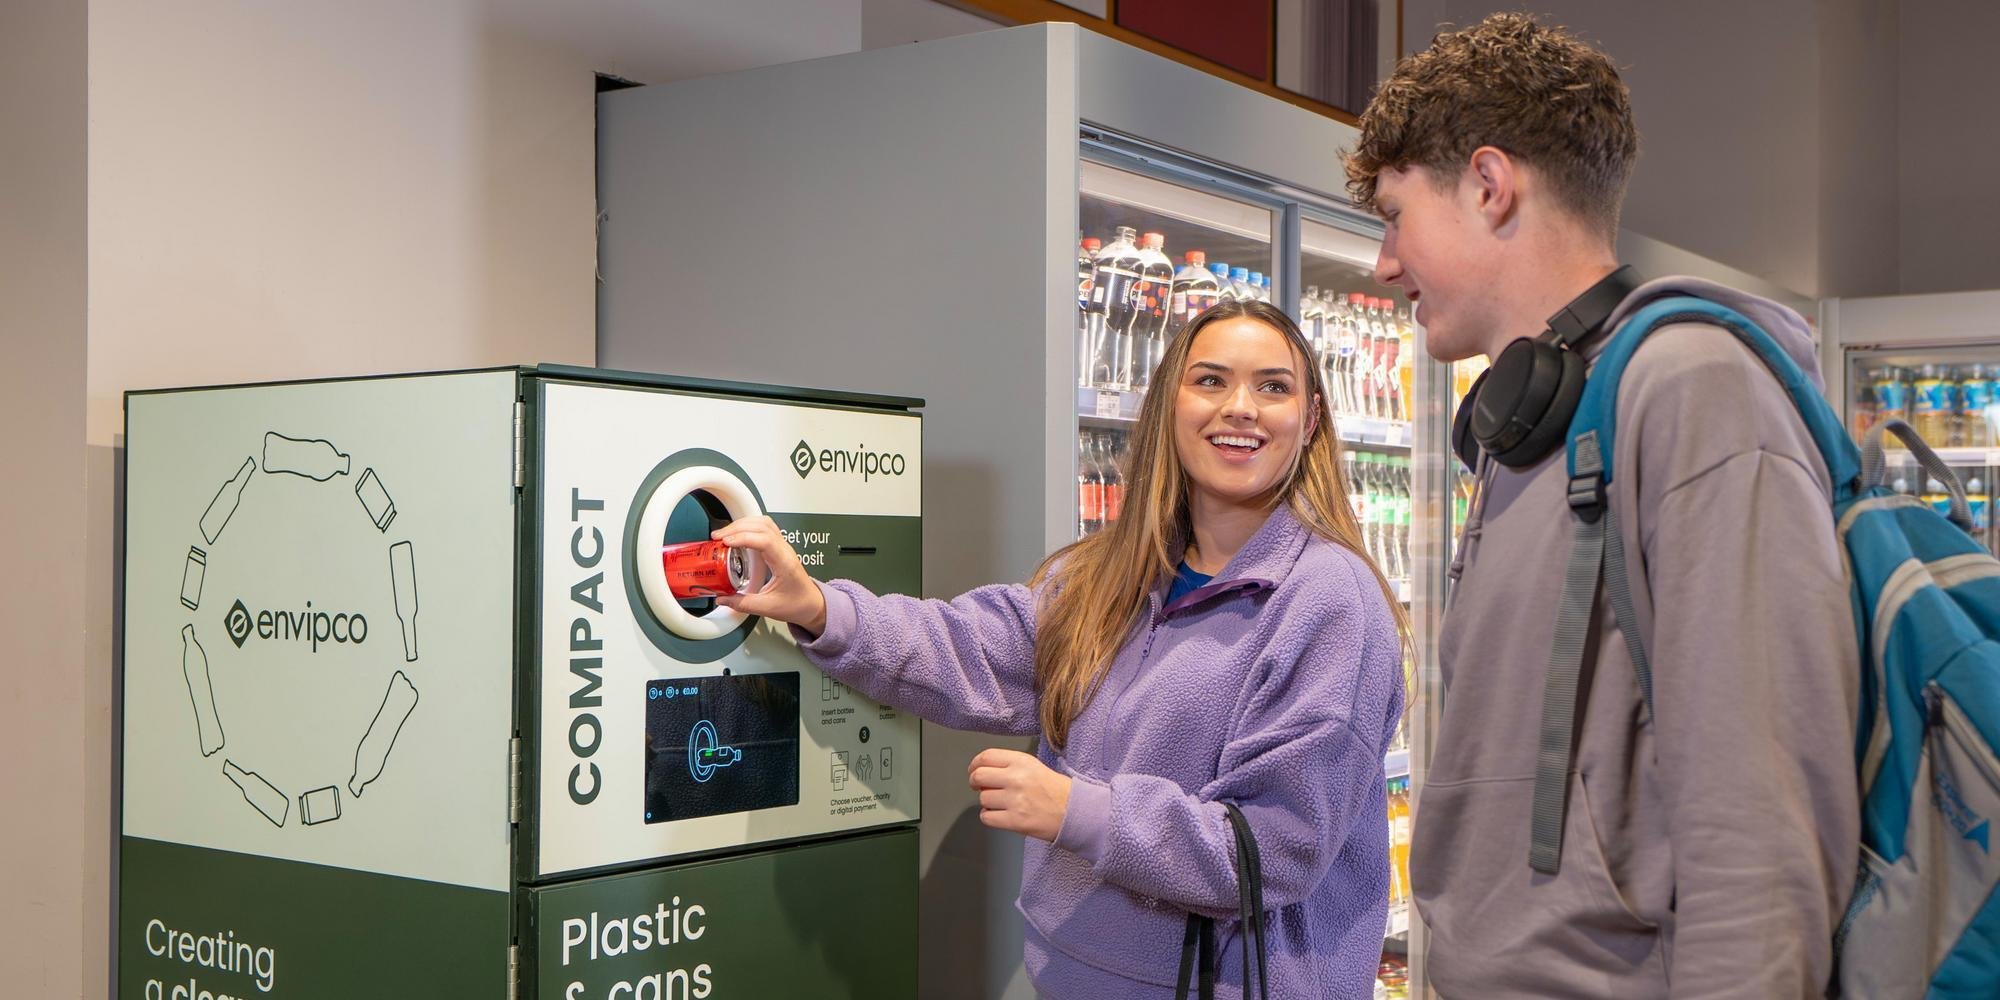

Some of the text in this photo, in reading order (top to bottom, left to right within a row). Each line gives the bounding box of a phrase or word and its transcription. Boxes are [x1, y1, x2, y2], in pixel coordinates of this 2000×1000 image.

[820, 443, 905, 482] envipco
[780, 529, 830, 549] Get your
[796, 550, 824, 566] osit
[257, 600, 368, 653] envipco
[568, 487, 604, 805] COMPACT
[821, 707, 855, 716] Insert bottles
[830, 798, 850, 806] Choose
[873, 792, 891, 801] charity
[836, 806, 853, 816] digital
[854, 803, 877, 814] payment
[562, 896, 706, 966] Plastic
[145, 918, 275, 992] Creating
